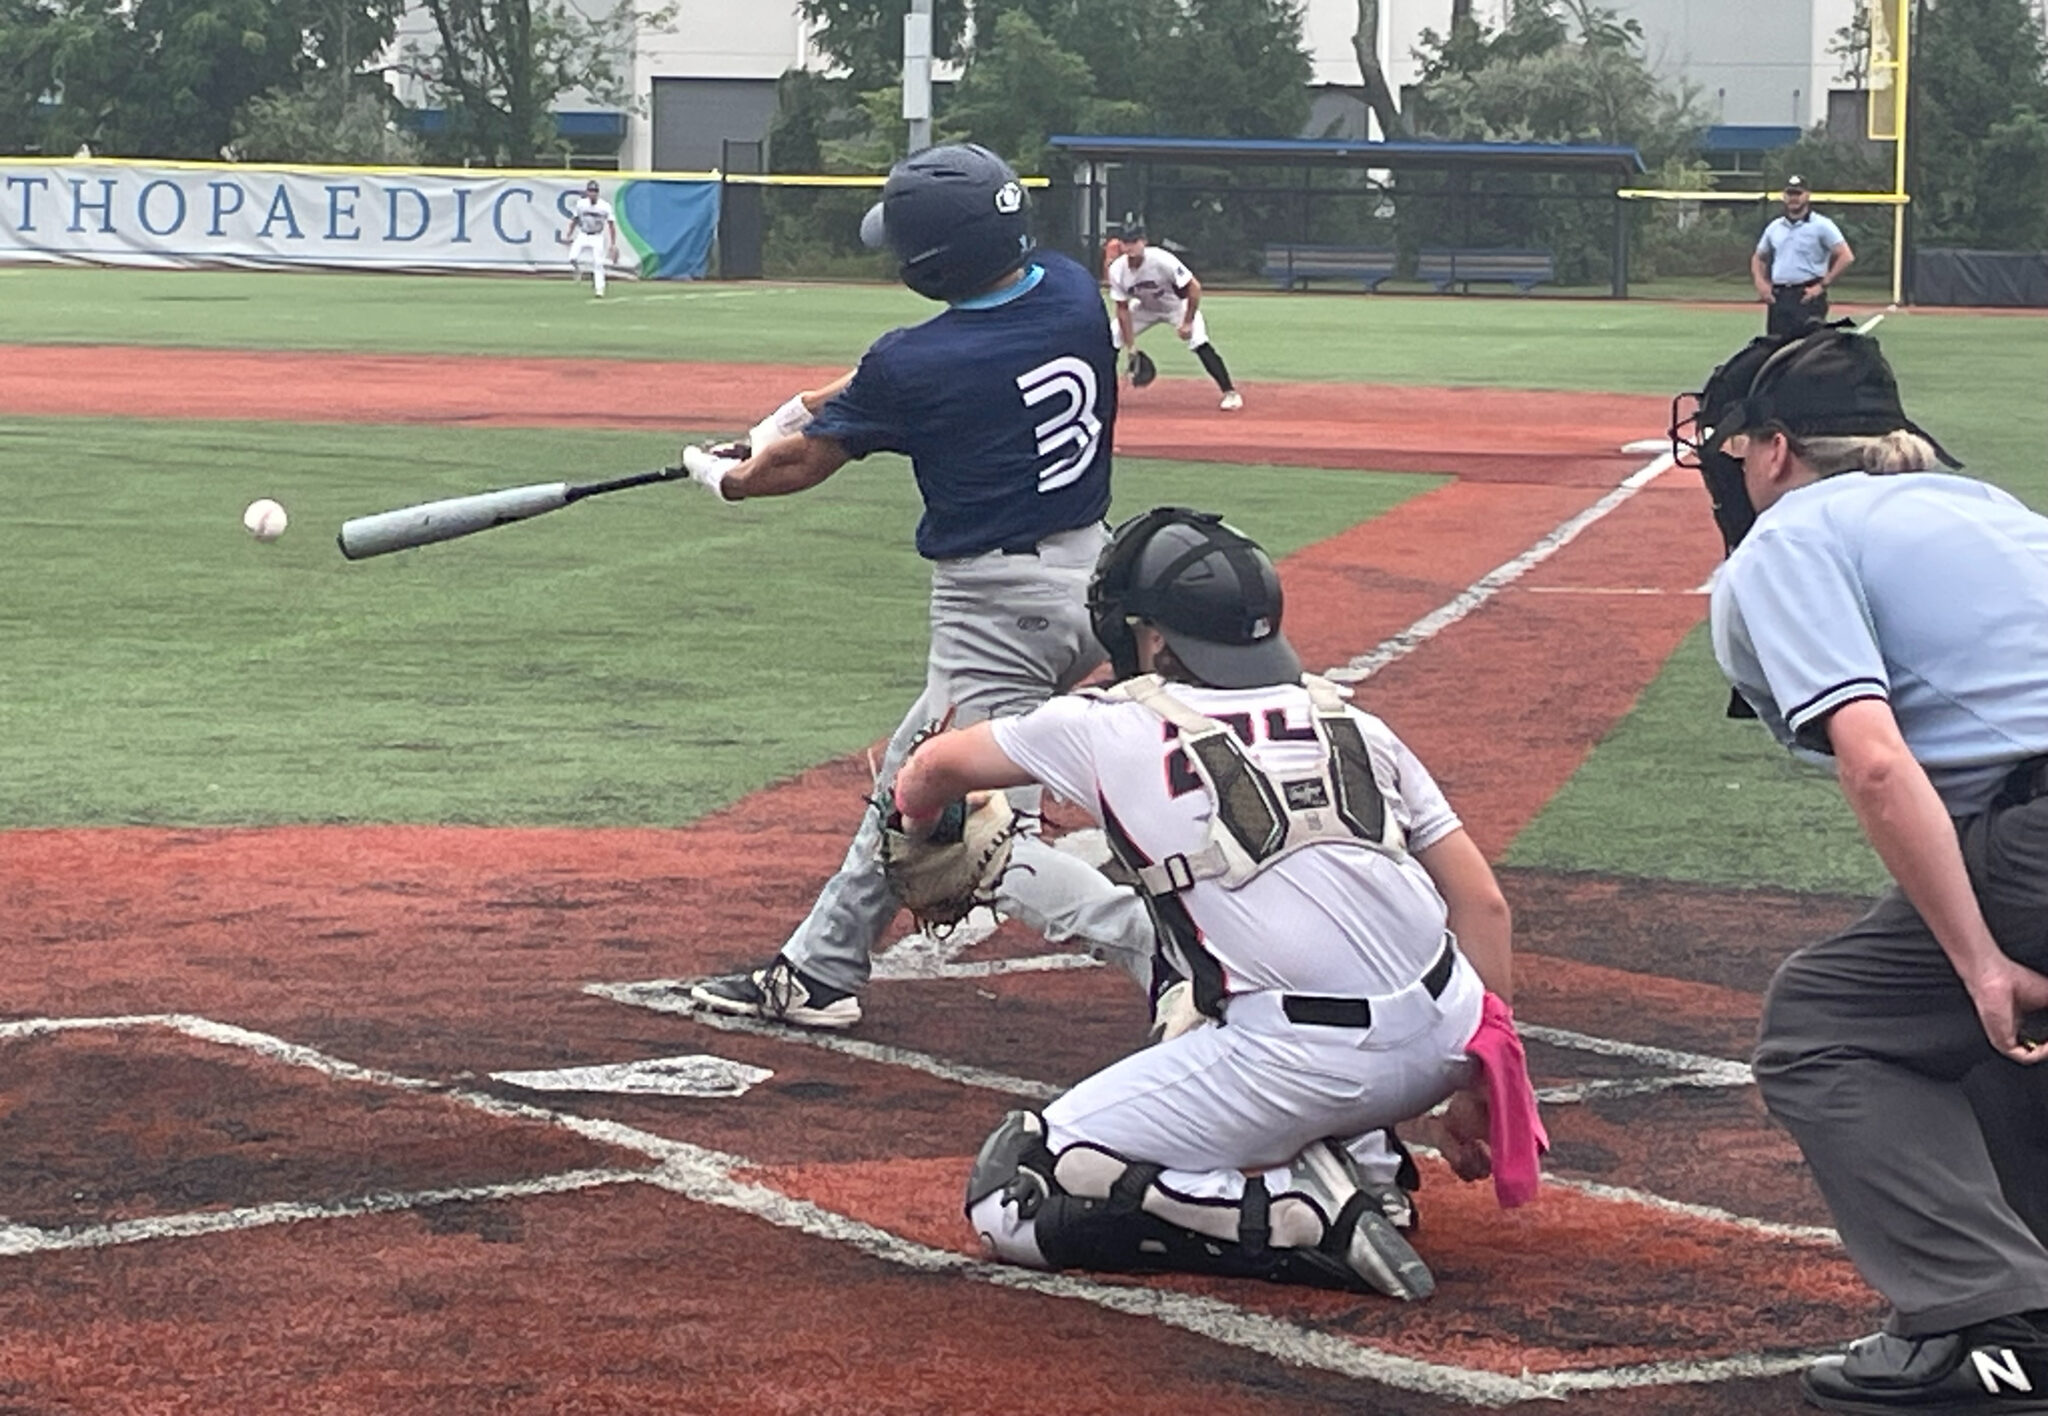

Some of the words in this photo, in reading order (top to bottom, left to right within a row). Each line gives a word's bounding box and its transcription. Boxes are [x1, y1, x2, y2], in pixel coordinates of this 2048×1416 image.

[7, 176, 589, 246] THOPAEDICS
[1016, 355, 1102, 493] 3
[1970, 1348, 2033, 1394] N
